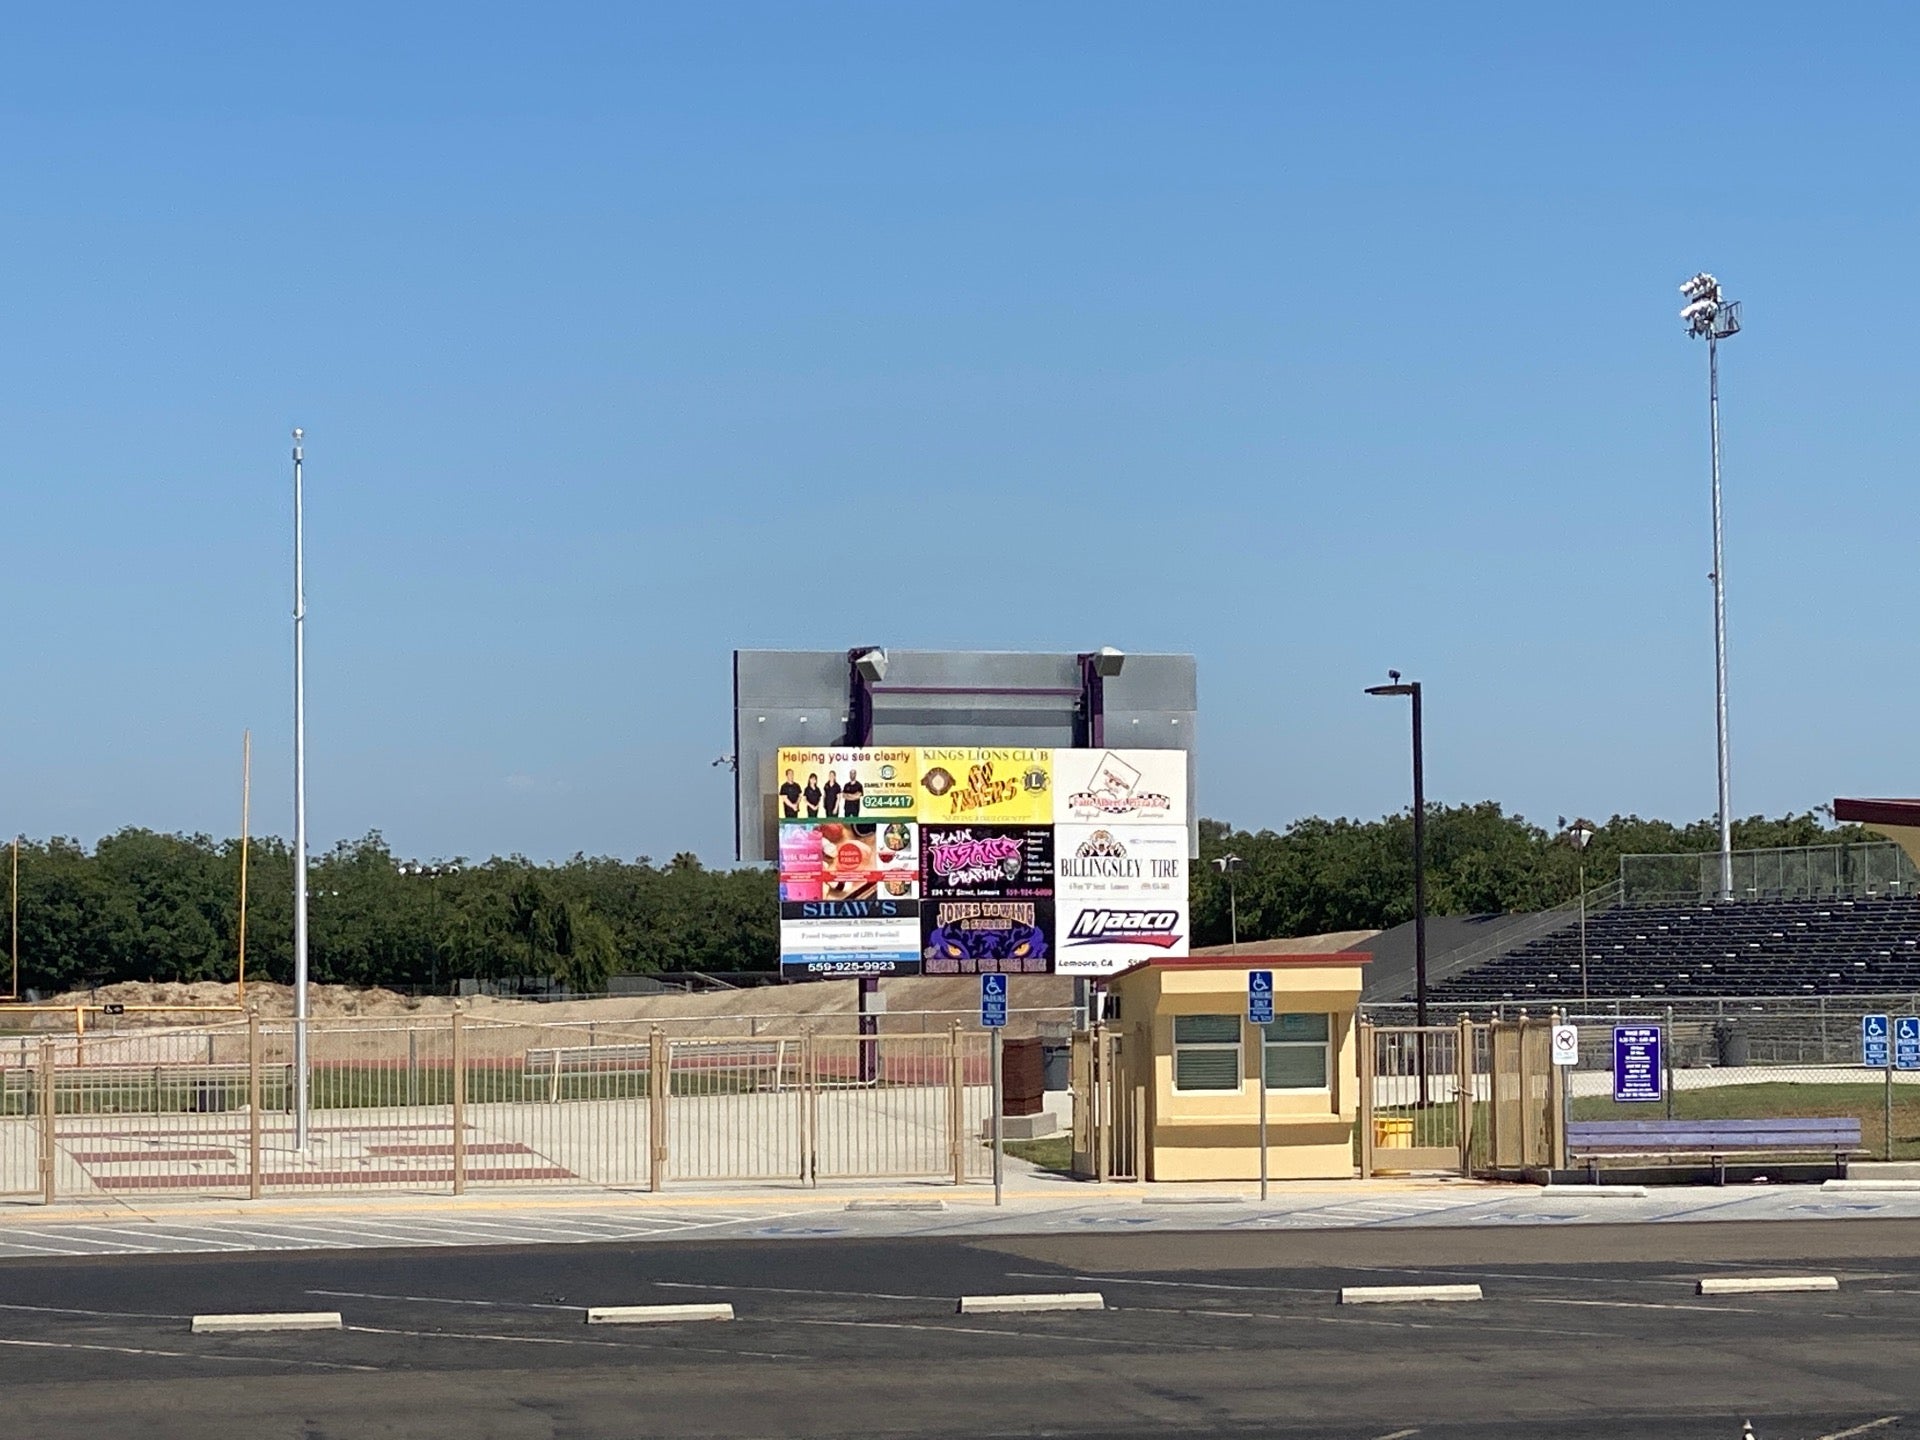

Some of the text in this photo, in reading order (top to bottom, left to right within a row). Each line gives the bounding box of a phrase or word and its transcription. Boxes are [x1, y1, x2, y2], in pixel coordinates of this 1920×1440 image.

[783, 751, 911, 764] Helping you see clearly
[923, 750, 1049, 762] KINGS LIONS CLUB
[864, 796, 912, 807] 924-4417
[930, 829, 972, 845] PLAIN
[929, 836, 1024, 876] INSANE
[1061, 859, 1179, 878] BILLINGSLEY TIRE
[803, 901, 897, 917] SHAW'S
[937, 902, 1035, 928] JONES TOWING
[1067, 909, 1179, 939] Maaco
[808, 962, 896, 972] 559-925-9923
[1059, 960, 1099, 968] Lemoore,
